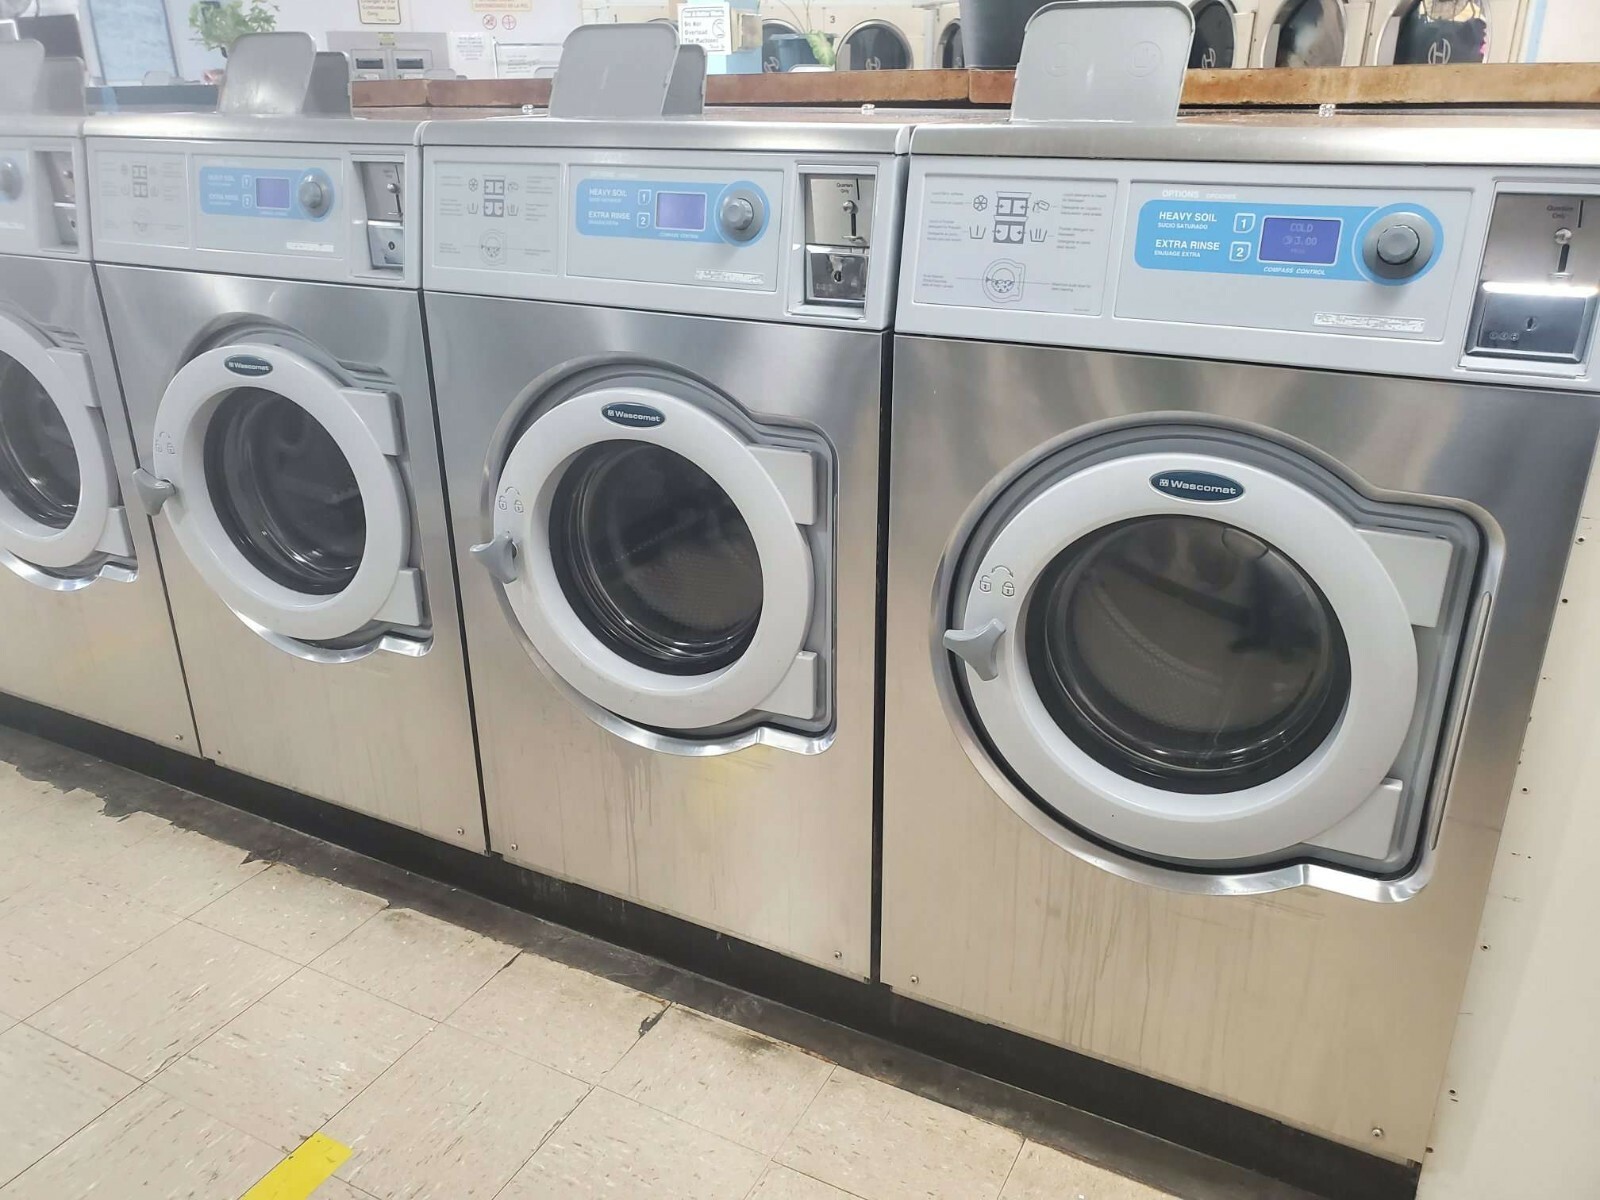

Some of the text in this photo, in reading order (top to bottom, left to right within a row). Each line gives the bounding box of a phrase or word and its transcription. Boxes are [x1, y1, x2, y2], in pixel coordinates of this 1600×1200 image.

[829, 15, 836, 24] 3
[589, 188, 628, 197] HEAVY SOIL
[1161, 189, 1200, 199] OPTIONS
[588, 211, 631, 220] EXTRA RINSE
[1159, 211, 1218, 222] HEAVY SOIL
[1241, 218, 1247, 230] 1
[1290, 222, 1314, 233] COLD
[1155, 239, 1220, 251] EXTRA RINSE
[1235, 247, 1244, 258] 2
[1263, 266, 1326, 276] COMPASS CONTROL
[614, 410, 661, 422] Wascomat
[1170, 479, 1237, 495] Wascomat
